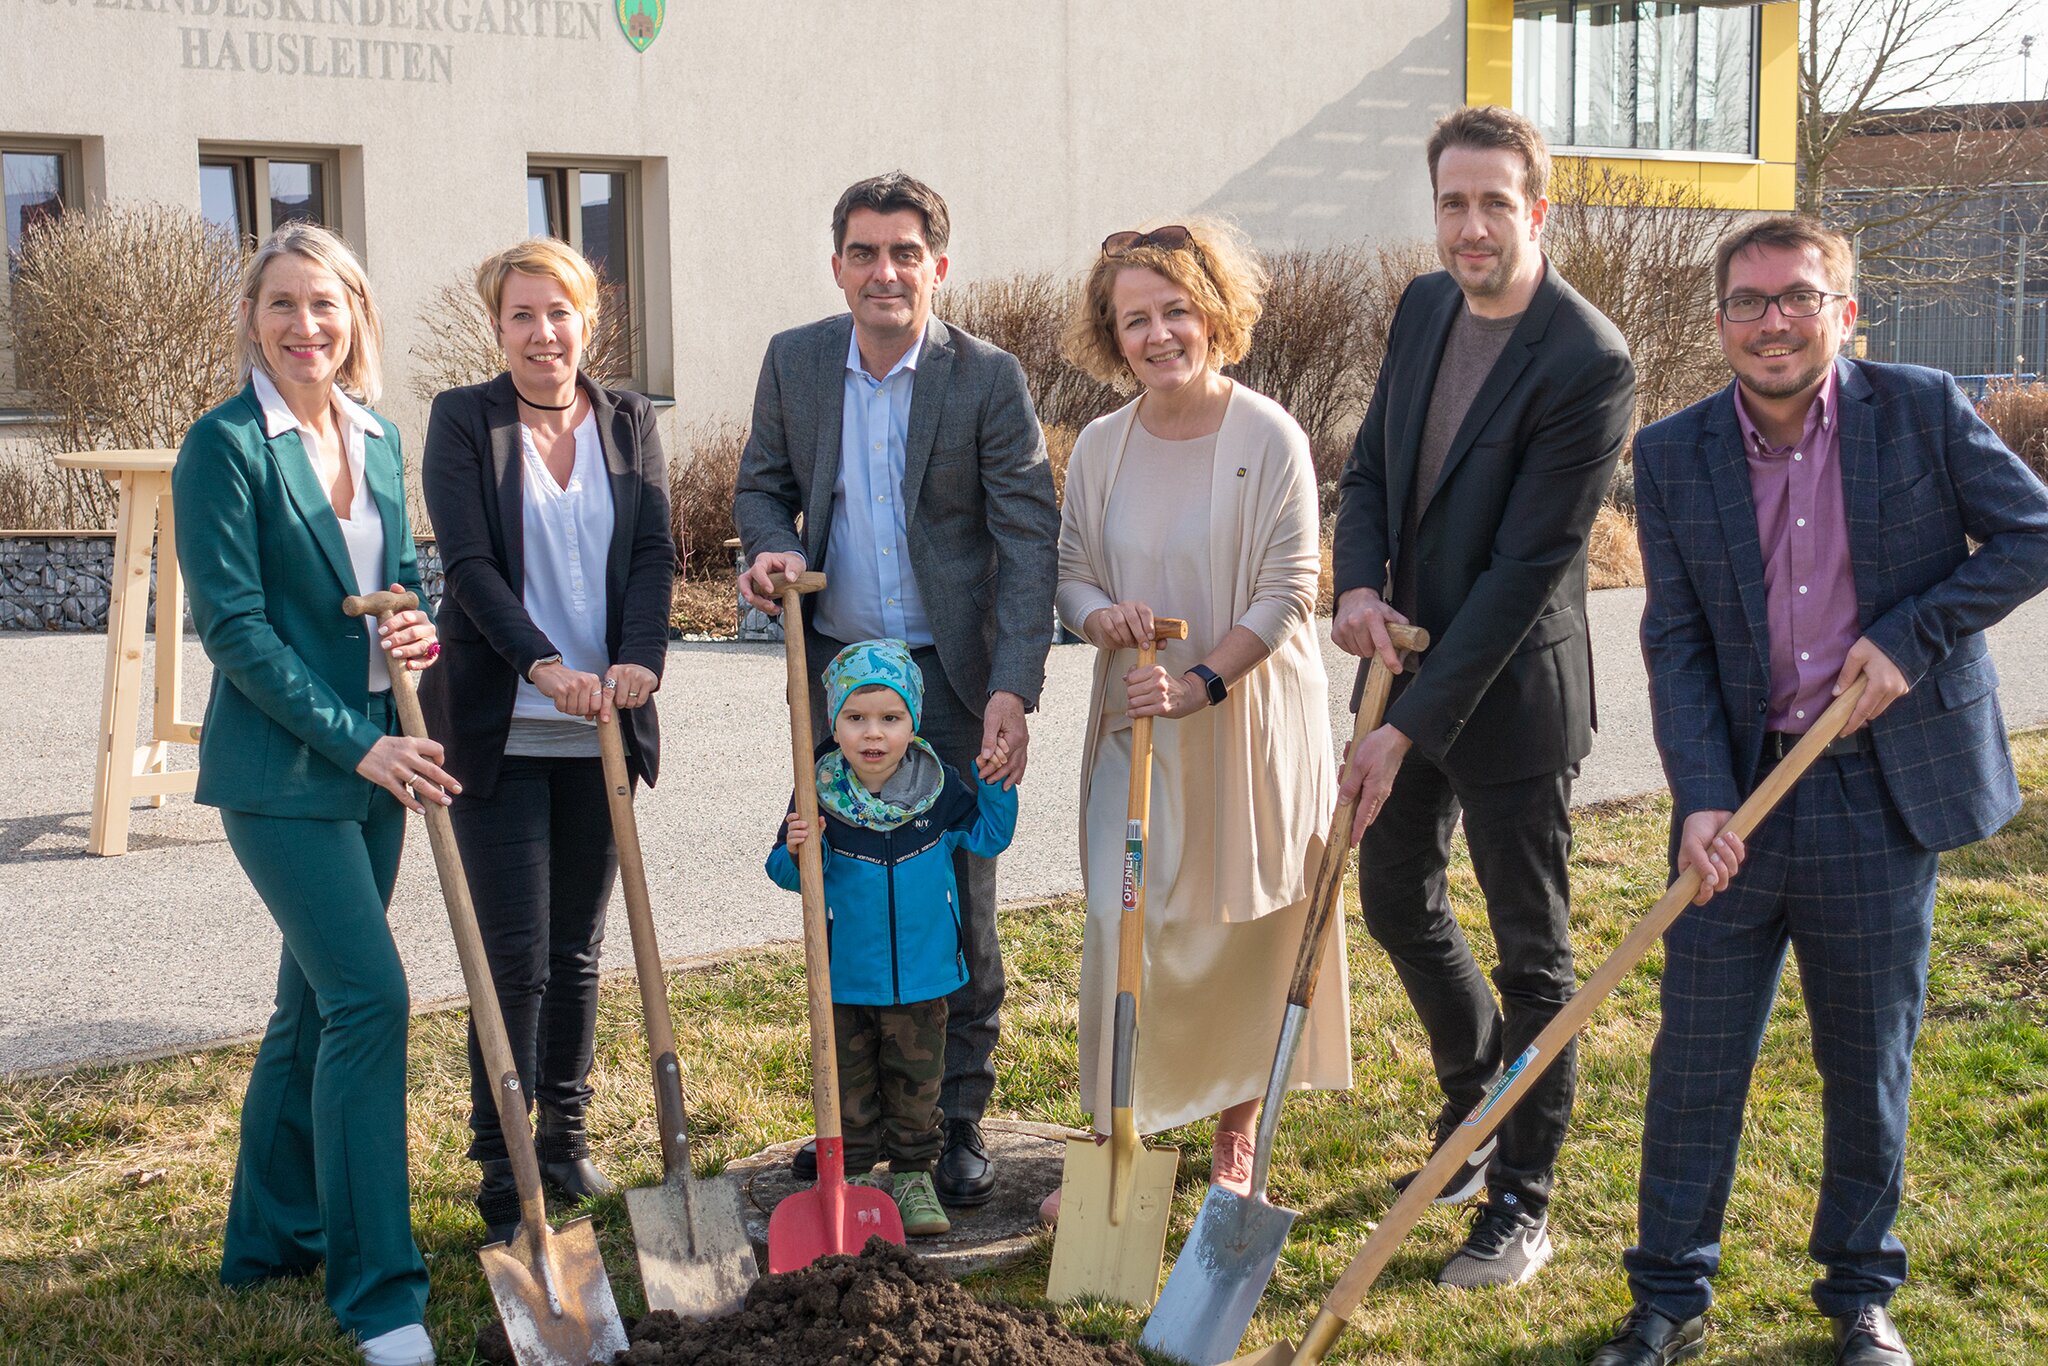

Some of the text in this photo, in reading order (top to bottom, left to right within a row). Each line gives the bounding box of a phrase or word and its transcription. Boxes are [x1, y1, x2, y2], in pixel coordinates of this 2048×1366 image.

[93, 0, 602, 42] KINDERGARTEN
[178, 26, 455, 84] HAUSLEITEN
[1123, 852, 1134, 902] OFFNER
